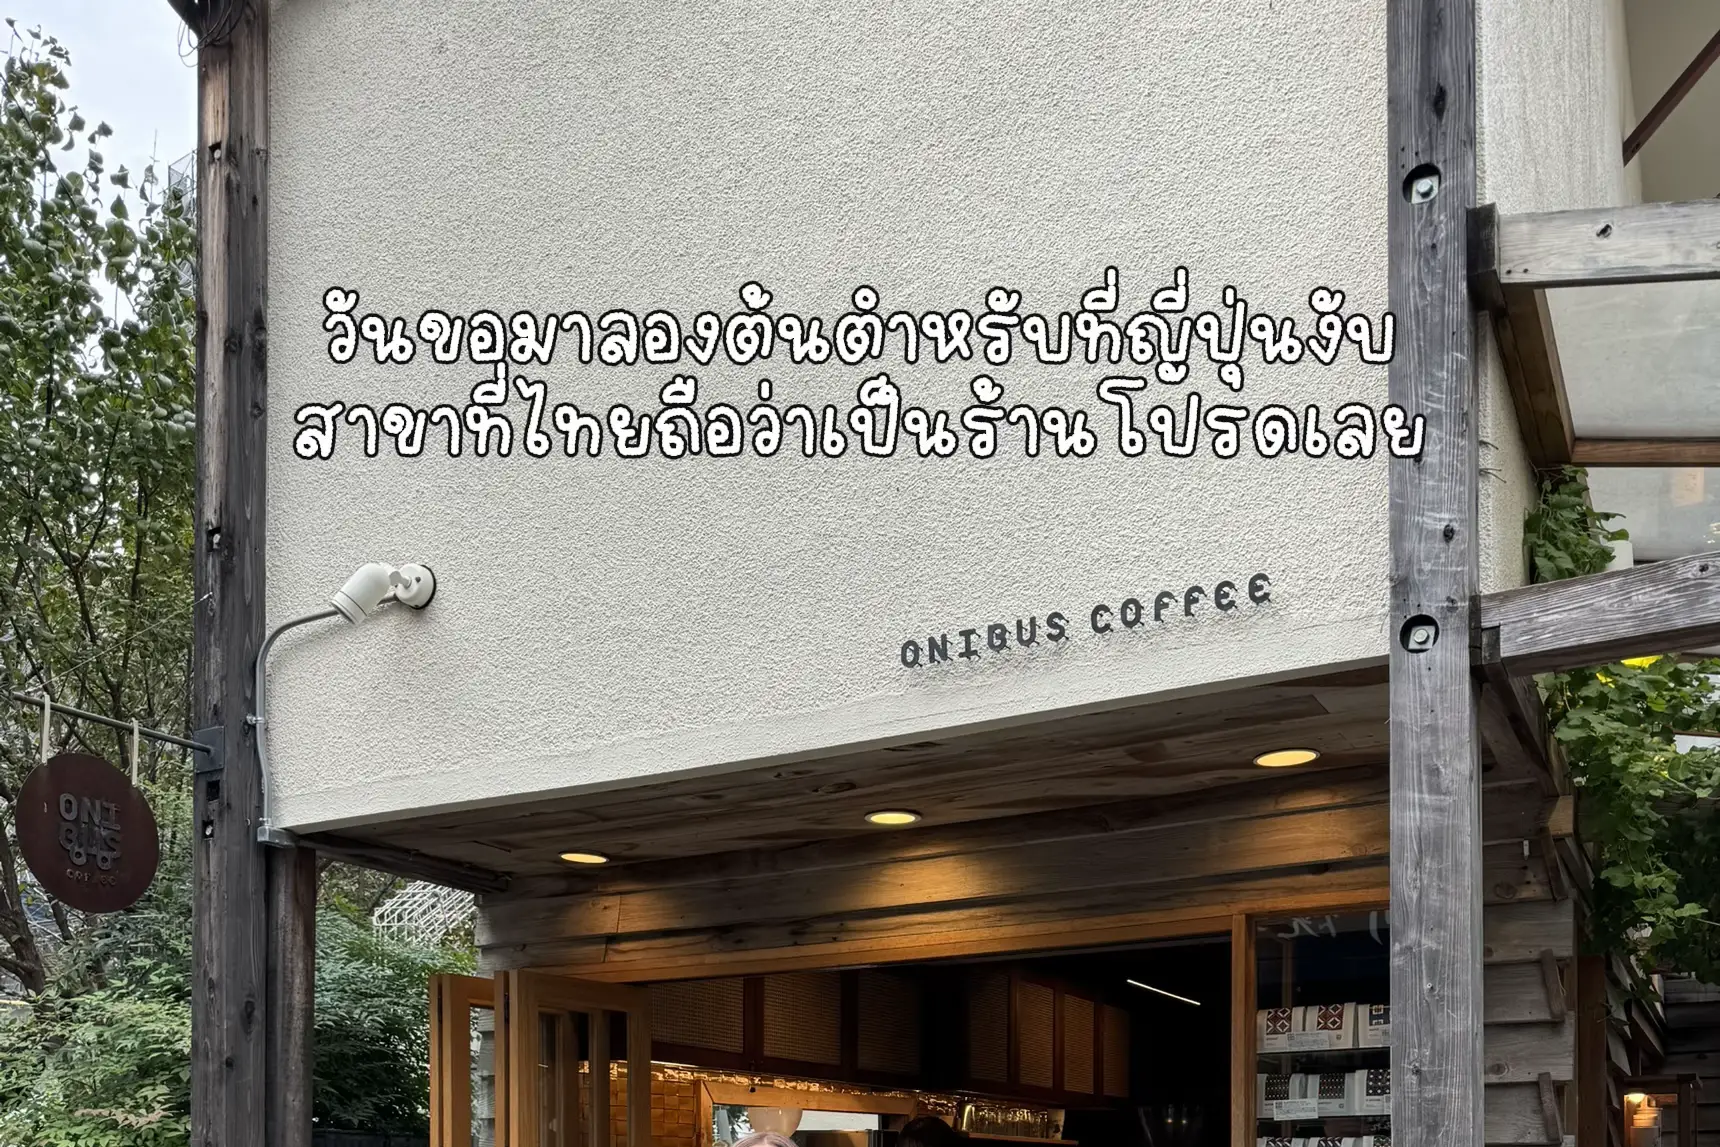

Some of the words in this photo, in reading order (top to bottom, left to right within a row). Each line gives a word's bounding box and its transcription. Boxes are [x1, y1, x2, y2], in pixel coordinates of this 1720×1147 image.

[900, 611, 1070, 668] ONIBUS
[1090, 573, 1273, 635] COFFEE
[59, 792, 121, 831] ONI
